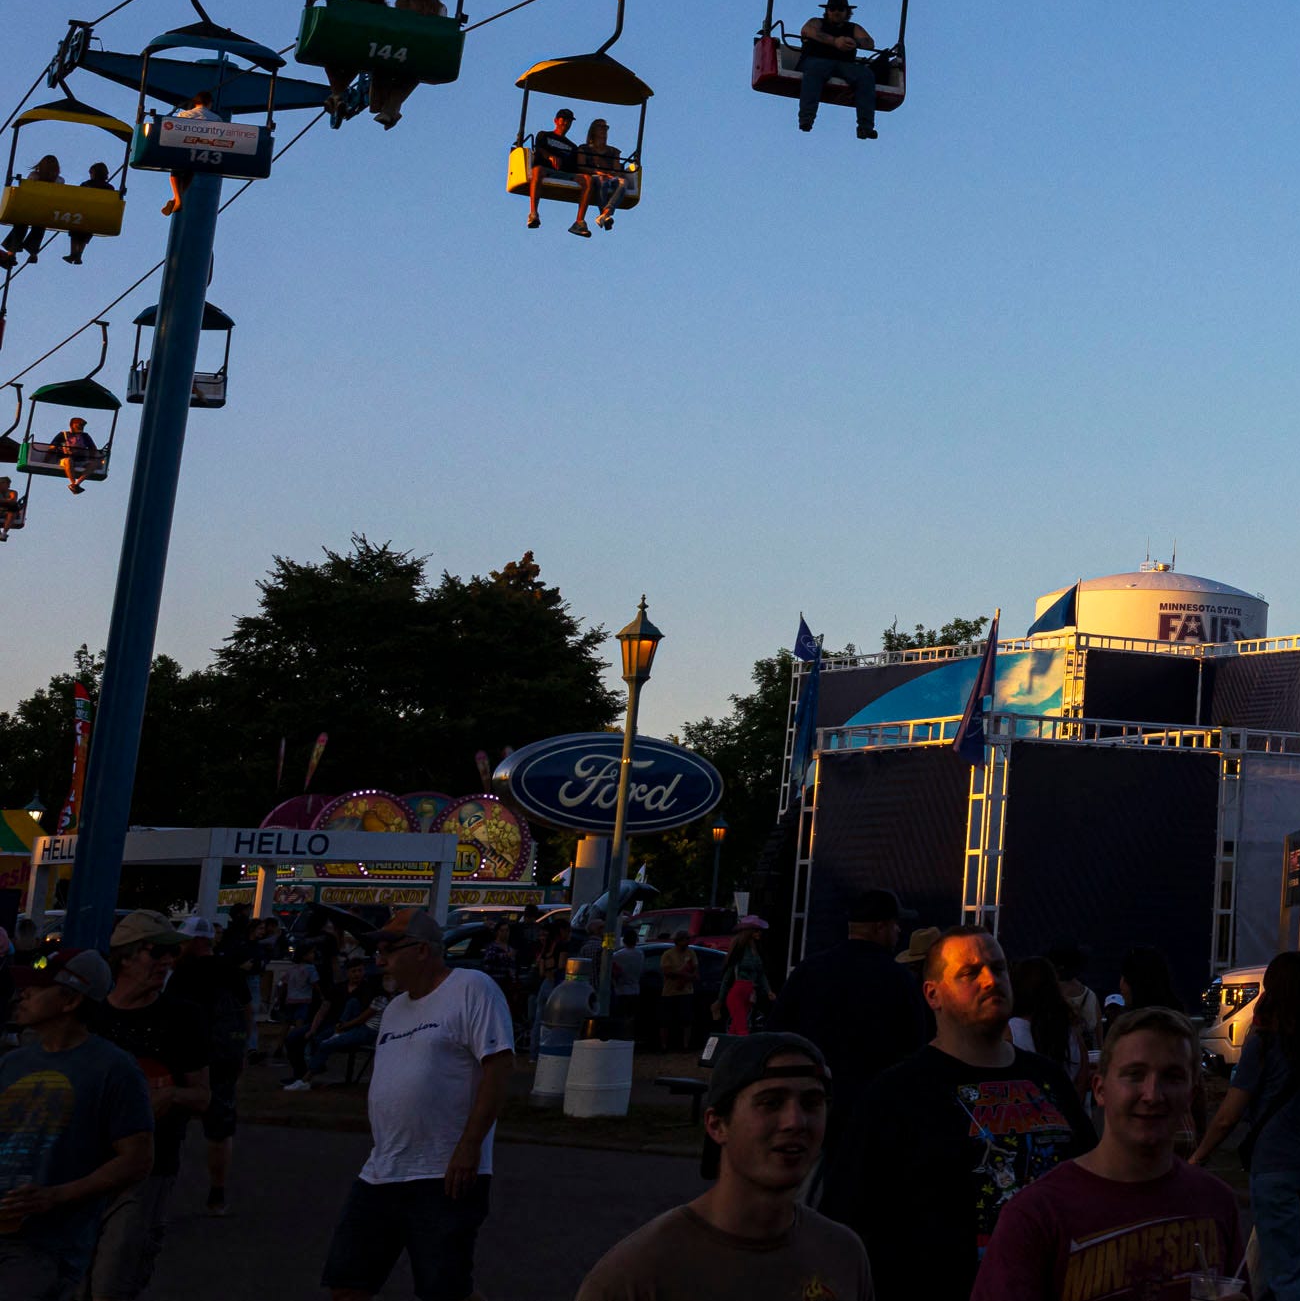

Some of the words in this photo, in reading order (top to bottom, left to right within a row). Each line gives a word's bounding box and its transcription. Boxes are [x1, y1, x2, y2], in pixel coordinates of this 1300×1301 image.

[369, 42, 408, 62] 144
[191, 125, 226, 137] country
[190, 148, 222, 164] 143
[53, 210, 83, 225] 142
[1159, 602, 1216, 614] MINNESOTA
[1217, 605, 1242, 616] STATE
[1158, 613, 1245, 642] FAIR
[558, 754, 683, 812] Ford
[42, 839, 75, 861] HELL
[234, 831, 330, 856] HELLO
[321, 887, 377, 903] COTTON
[378, 888, 429, 904] CANDY
[483, 890, 542, 905] KONES
[379, 1022, 440, 1045] Champion
[975, 1079, 1042, 1107] STAR
[968, 1099, 1073, 1138] WARS
[1061, 1215, 1220, 1301] MINNESOTA
